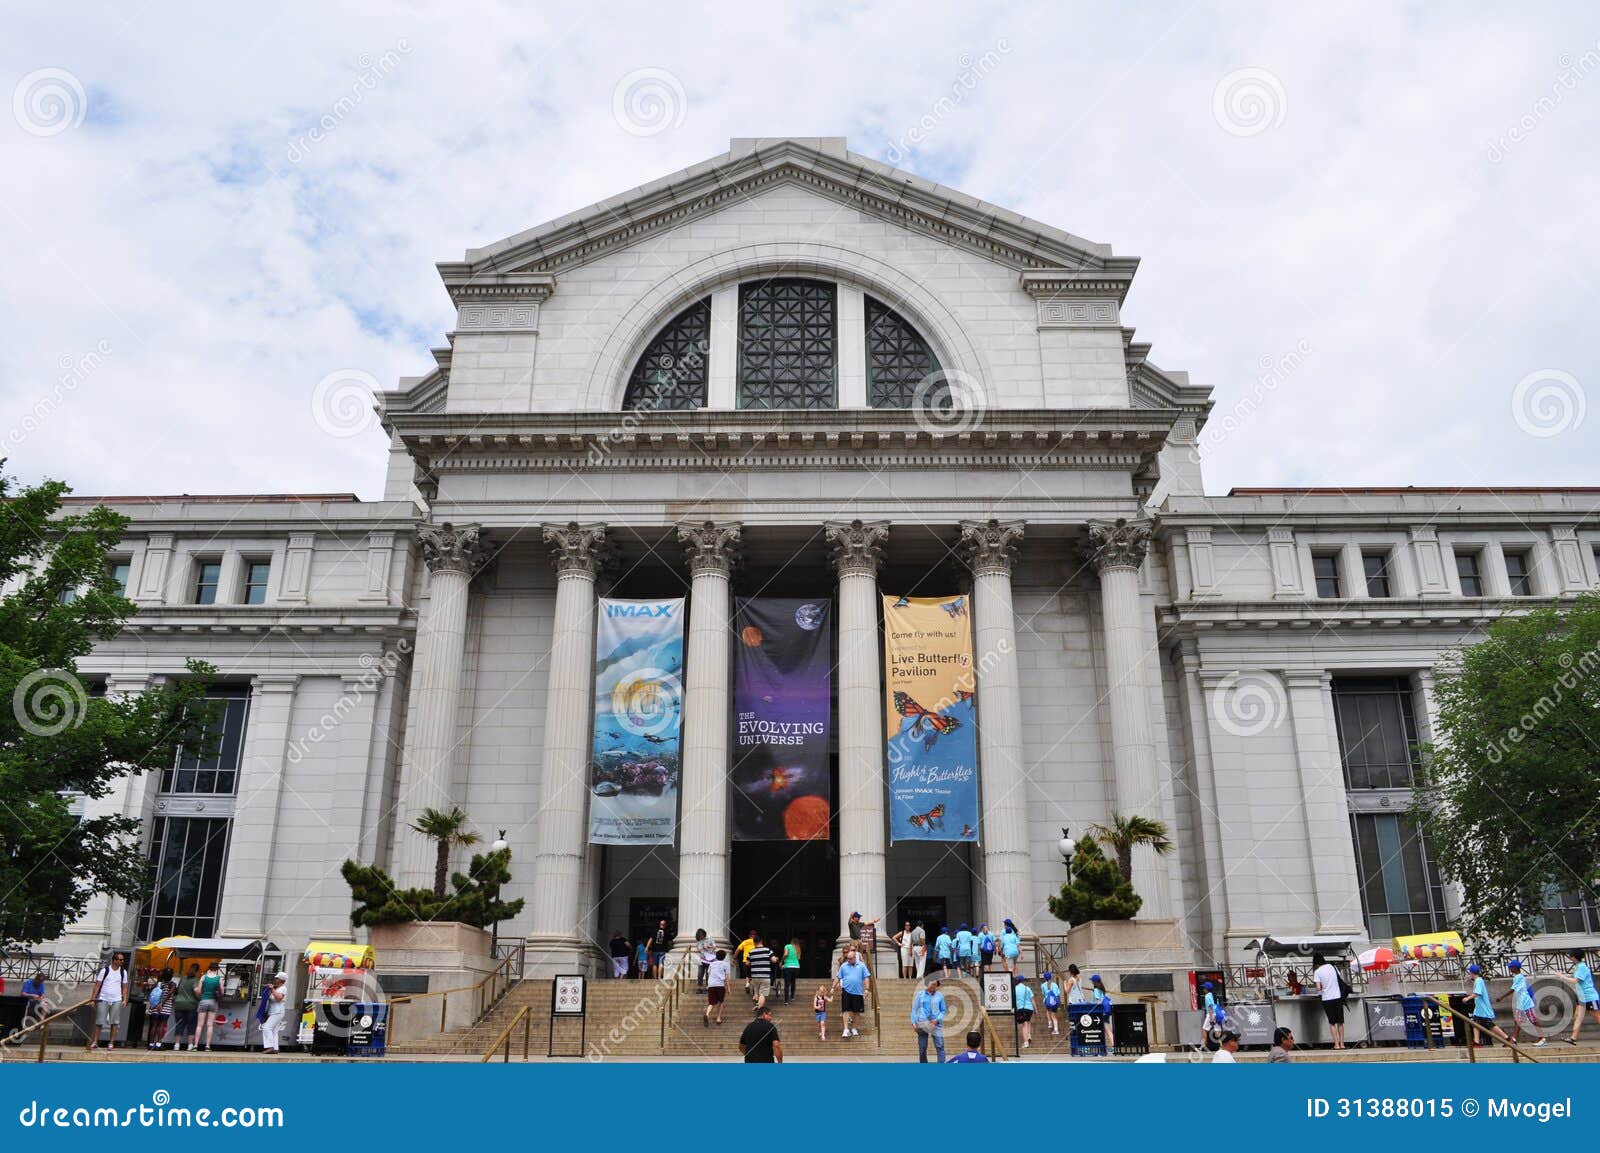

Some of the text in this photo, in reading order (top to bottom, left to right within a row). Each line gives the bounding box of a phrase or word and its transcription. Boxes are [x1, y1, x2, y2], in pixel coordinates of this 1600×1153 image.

[607, 604, 673, 618] IMAX
[891, 632, 913, 640] Come
[914, 631, 924, 639] fly
[891, 653, 968, 666] Live Butterfly
[891, 666, 937, 678] Pavilion
[739, 712, 755, 720] THE
[739, 720, 825, 735] EVOLVING
[739, 734, 804, 746] UNIVERSE
[892, 764, 921, 784] Flight
[927, 765, 974, 784] Butterflies
